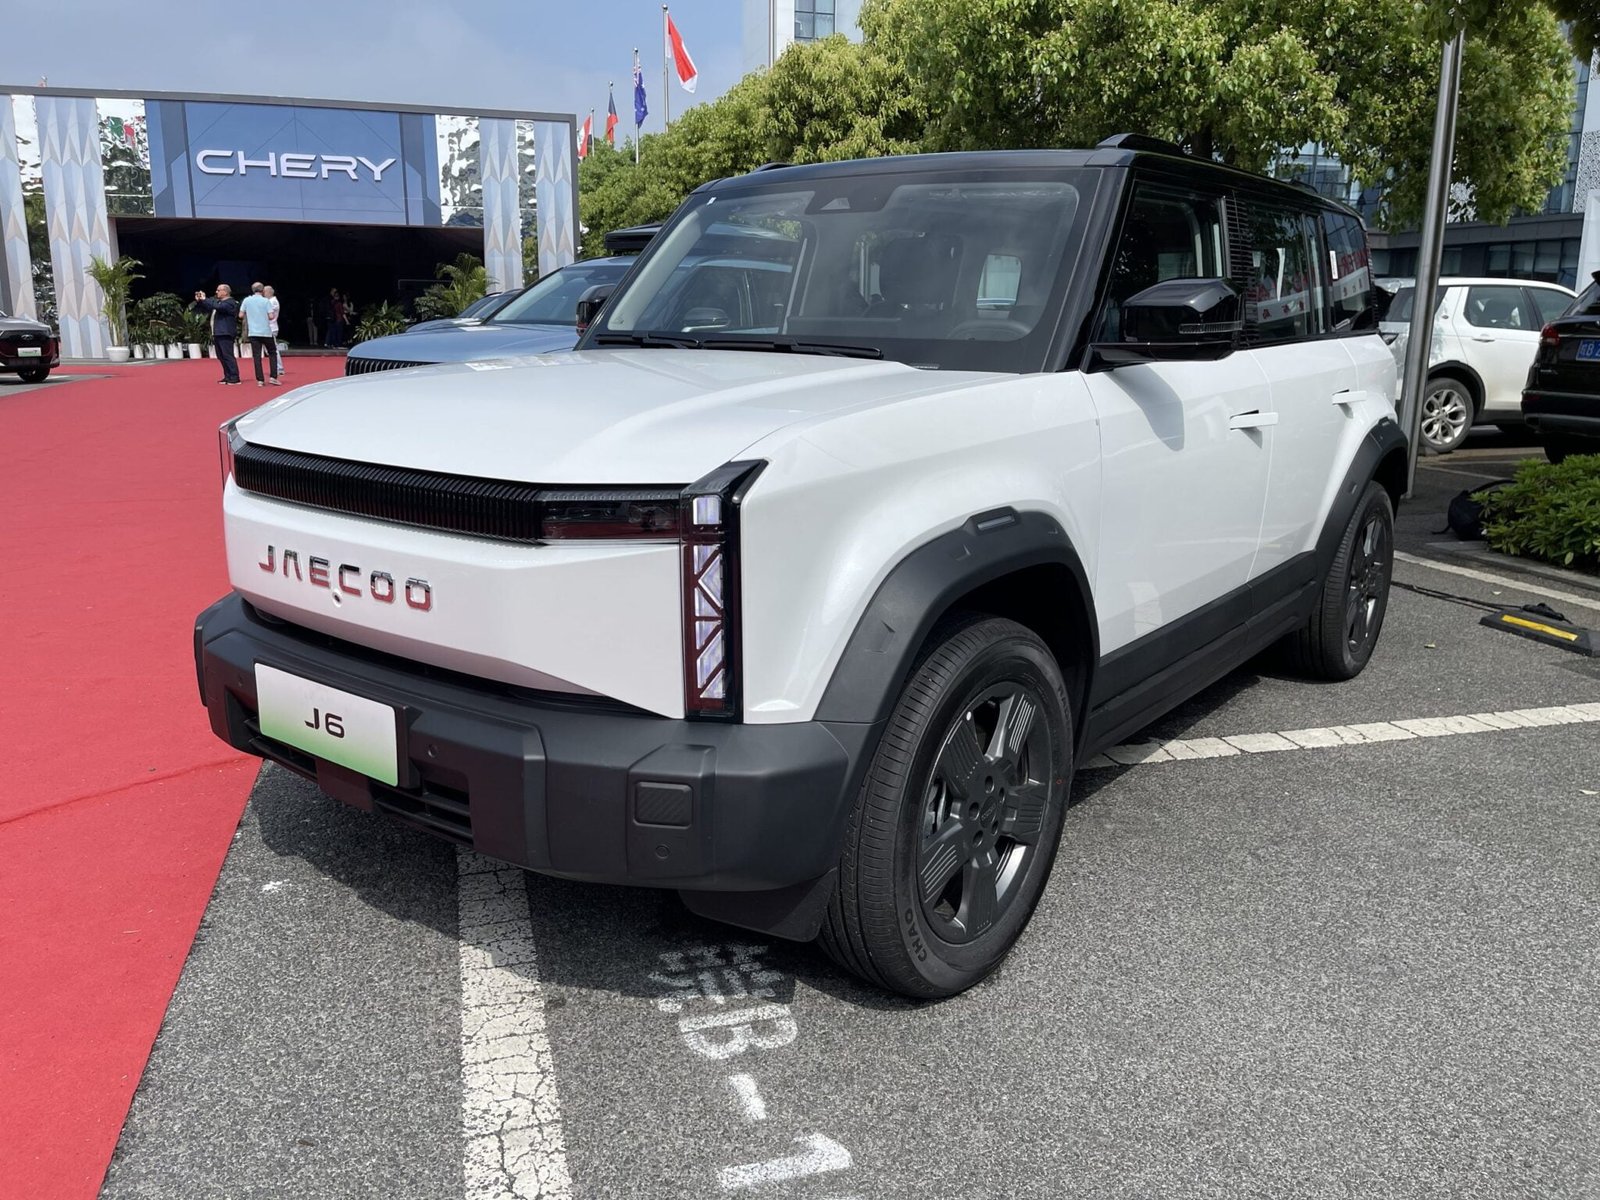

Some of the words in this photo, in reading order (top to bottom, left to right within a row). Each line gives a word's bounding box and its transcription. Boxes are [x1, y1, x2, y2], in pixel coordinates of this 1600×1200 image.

[196, 149, 397, 182] CHERY
[258, 544, 433, 613] JAECOO
[304, 707, 345, 739] J6
